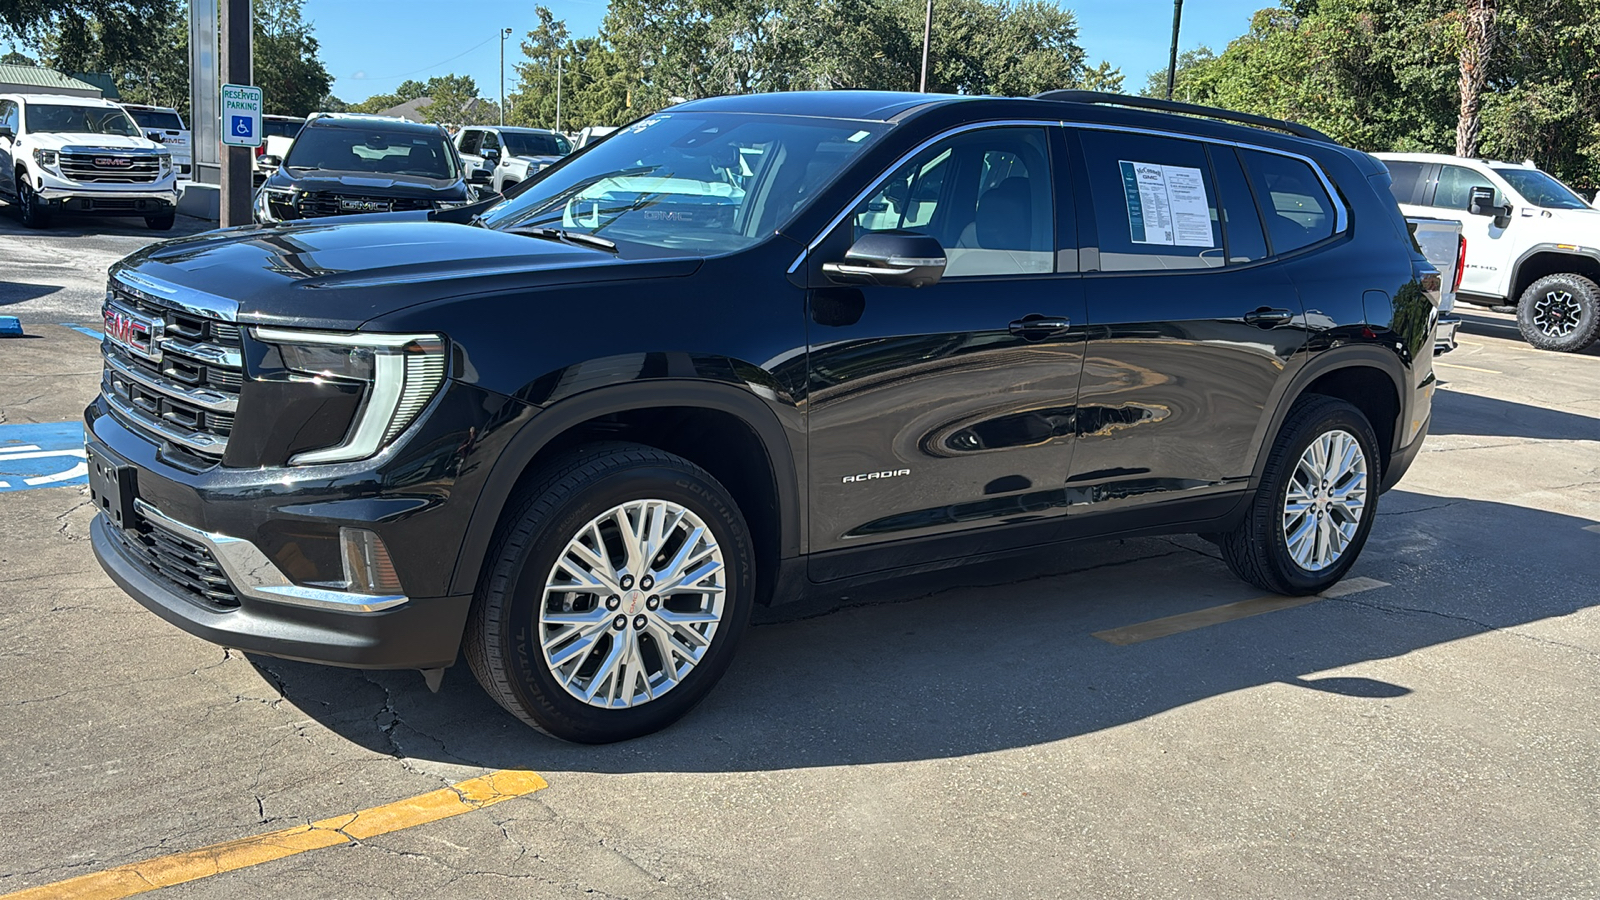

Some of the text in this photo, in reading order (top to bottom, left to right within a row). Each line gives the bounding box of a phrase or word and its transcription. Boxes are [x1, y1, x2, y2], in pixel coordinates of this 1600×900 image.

[224, 90, 259, 101] RESERVED
[226, 100, 257, 111] PARKING
[94, 157, 131, 166] GMC
[342, 200, 388, 211] GMC
[644, 210, 693, 221] GMC
[104, 309, 150, 351] GMC
[842, 468, 911, 484] ACADIA
[675, 477, 749, 588] CONTINENTAL
